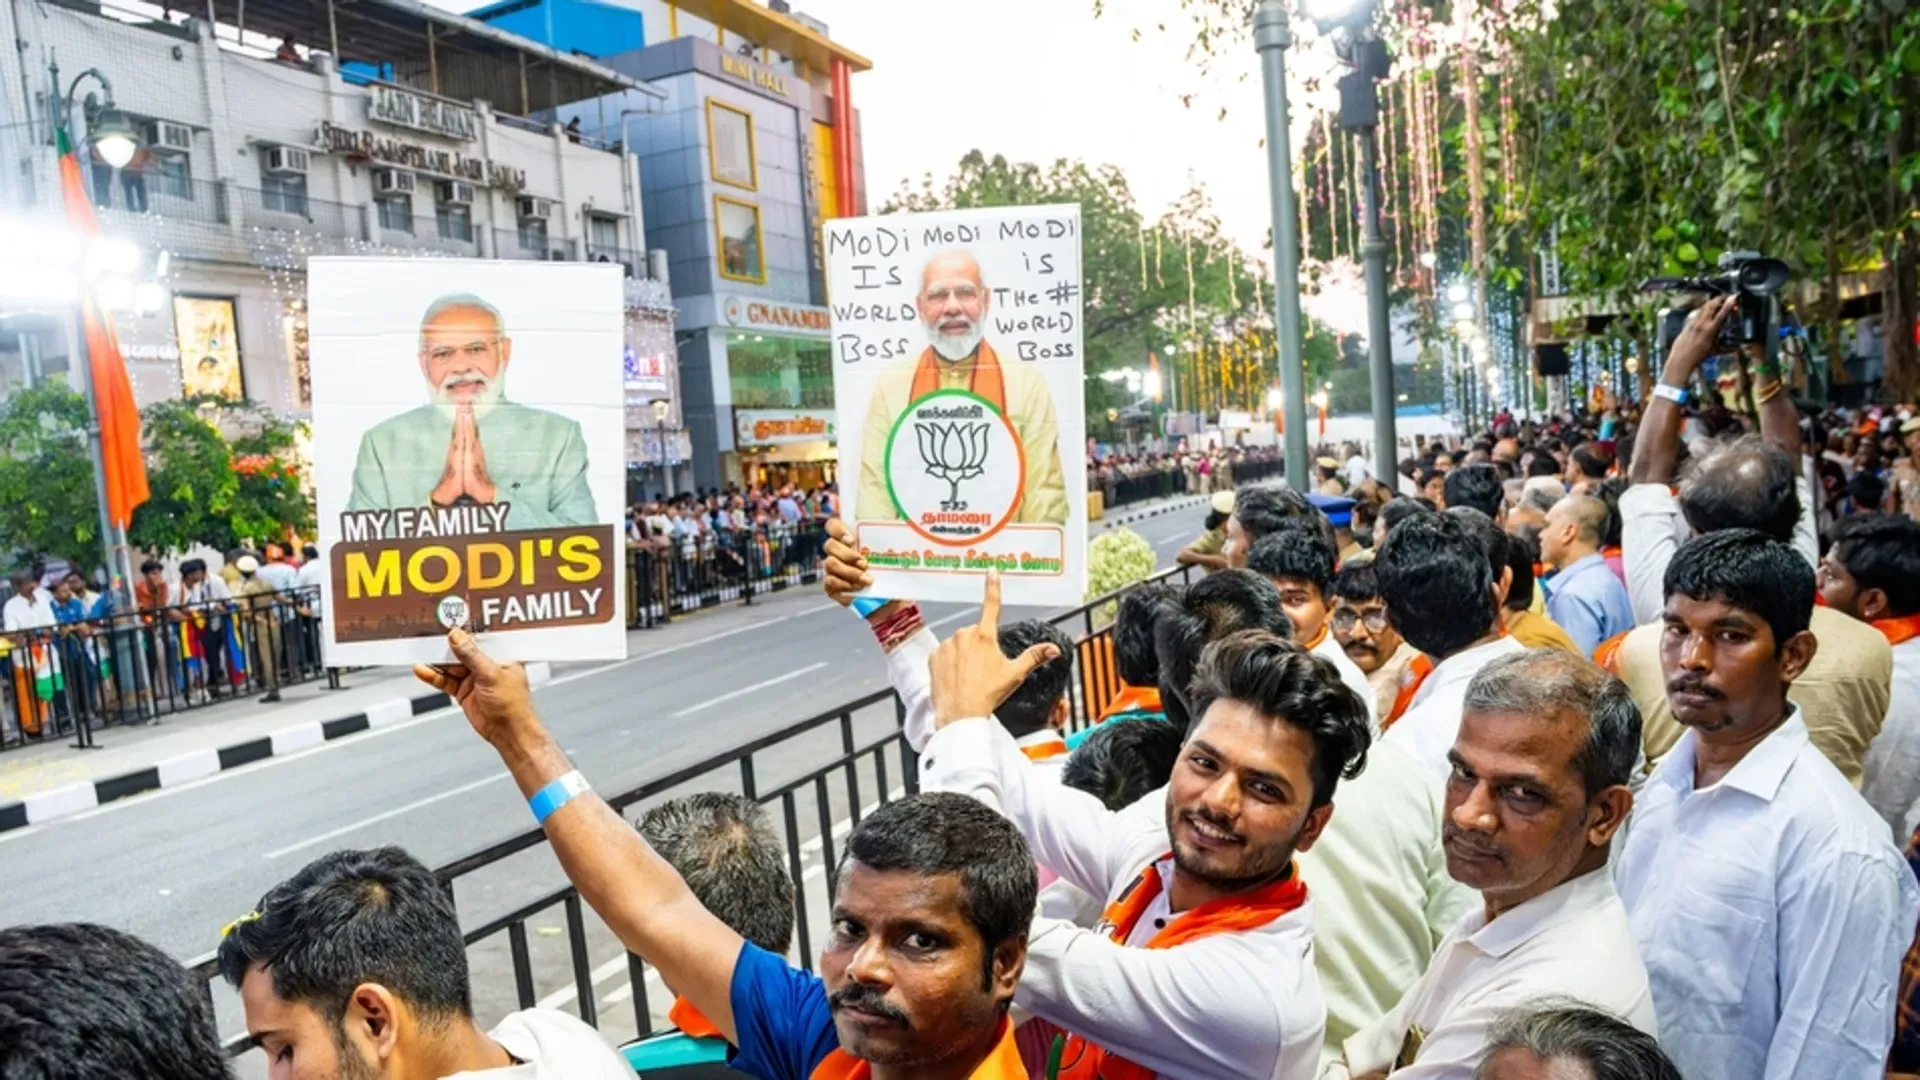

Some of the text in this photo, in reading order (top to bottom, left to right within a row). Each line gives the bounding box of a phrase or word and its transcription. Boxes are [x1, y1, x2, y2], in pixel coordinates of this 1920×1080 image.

[755, 69, 789, 97] HALL
[376, 87, 414, 124] JAIN
[852, 264, 903, 289] IS
[833, 303, 917, 323] WORLD
[343, 504, 509, 543] MY FAMILY
[921, 512, 992, 527] தாமரை
[344, 534, 603, 600] MODI'S
[481, 587, 604, 626] FAMILY
